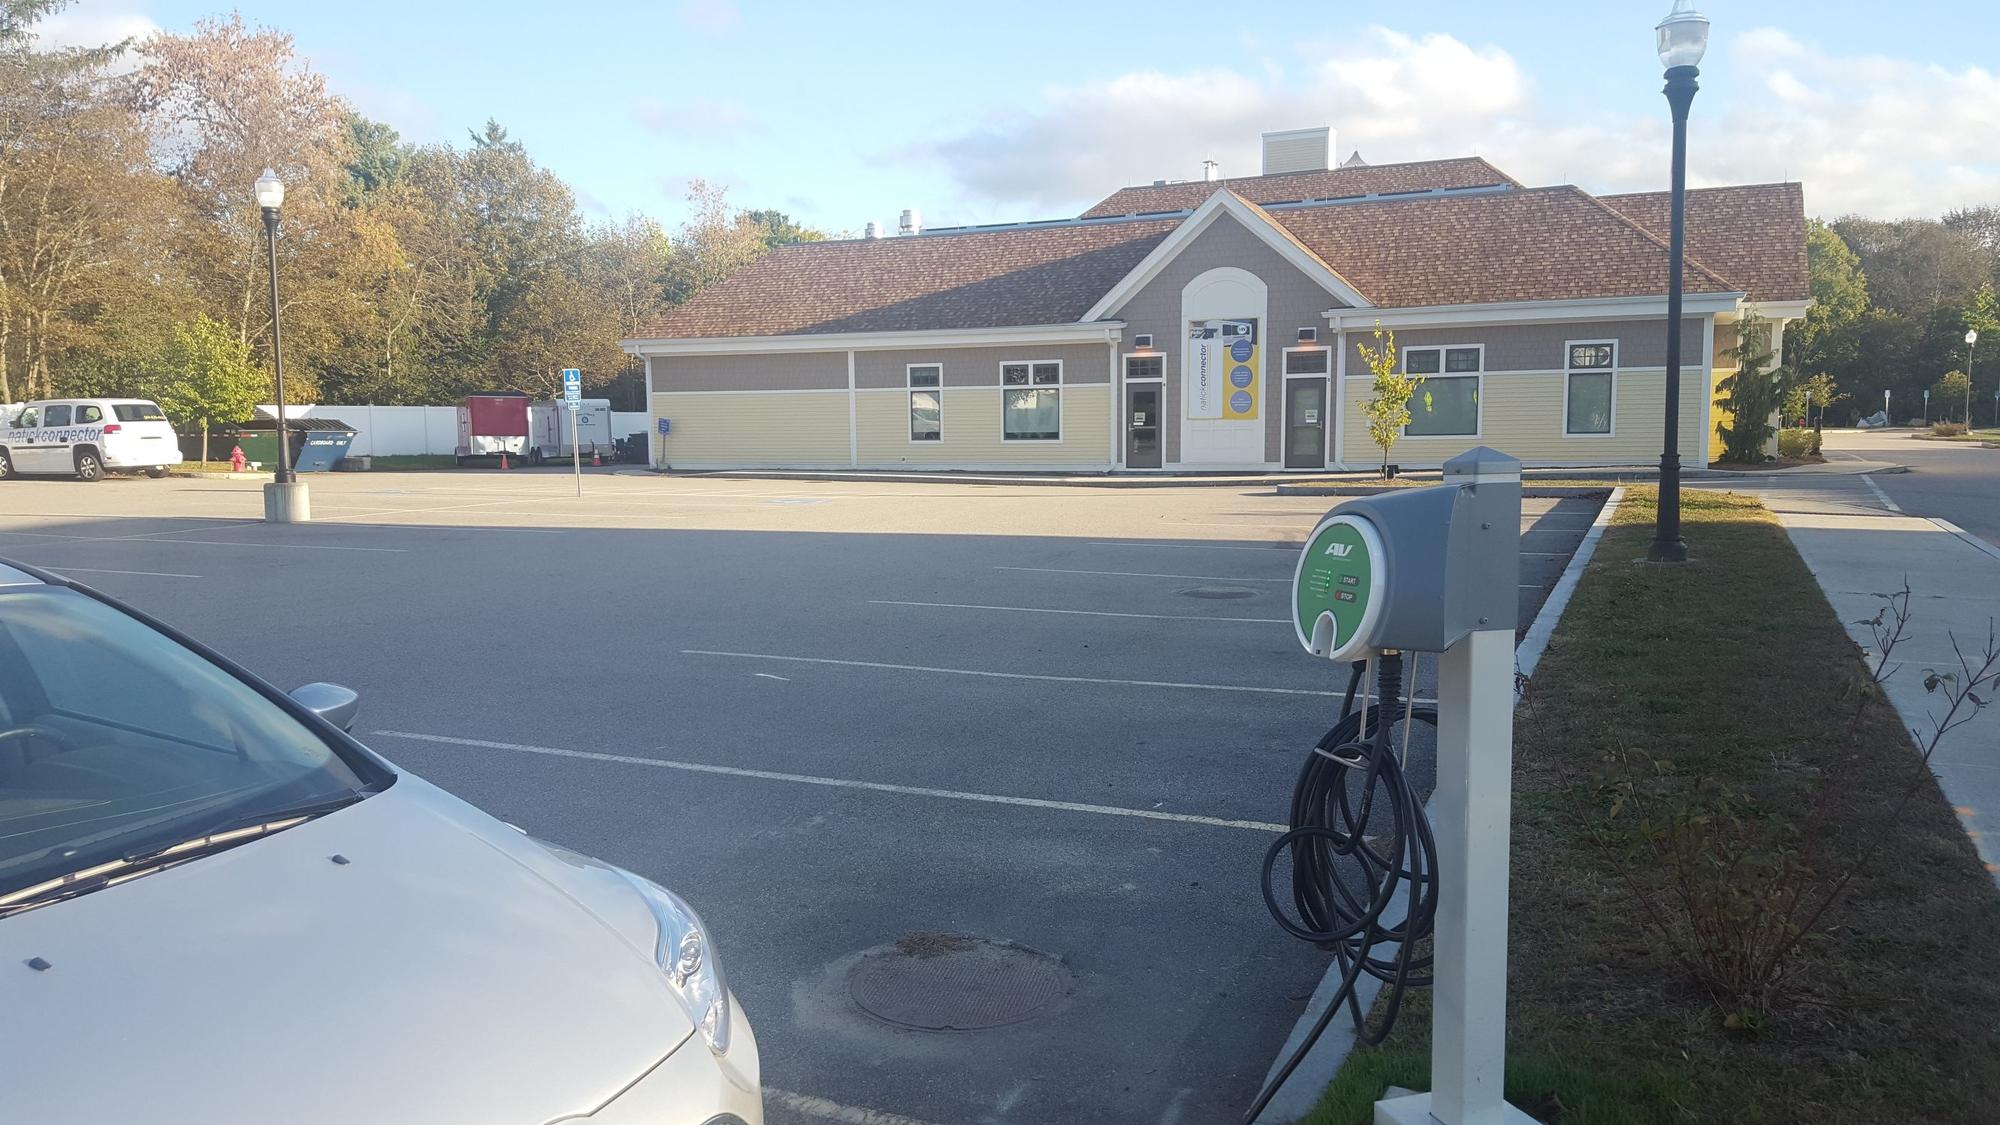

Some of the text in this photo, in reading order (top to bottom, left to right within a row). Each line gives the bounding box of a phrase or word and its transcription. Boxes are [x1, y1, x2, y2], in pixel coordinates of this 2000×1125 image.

[1199, 344, 1207, 411] natickconnector
[8, 427, 102, 443] natickconnector
[1324, 543, 1353, 557] AV
[1343, 576, 1356, 584] START
[1341, 592, 1353, 600] STOP
